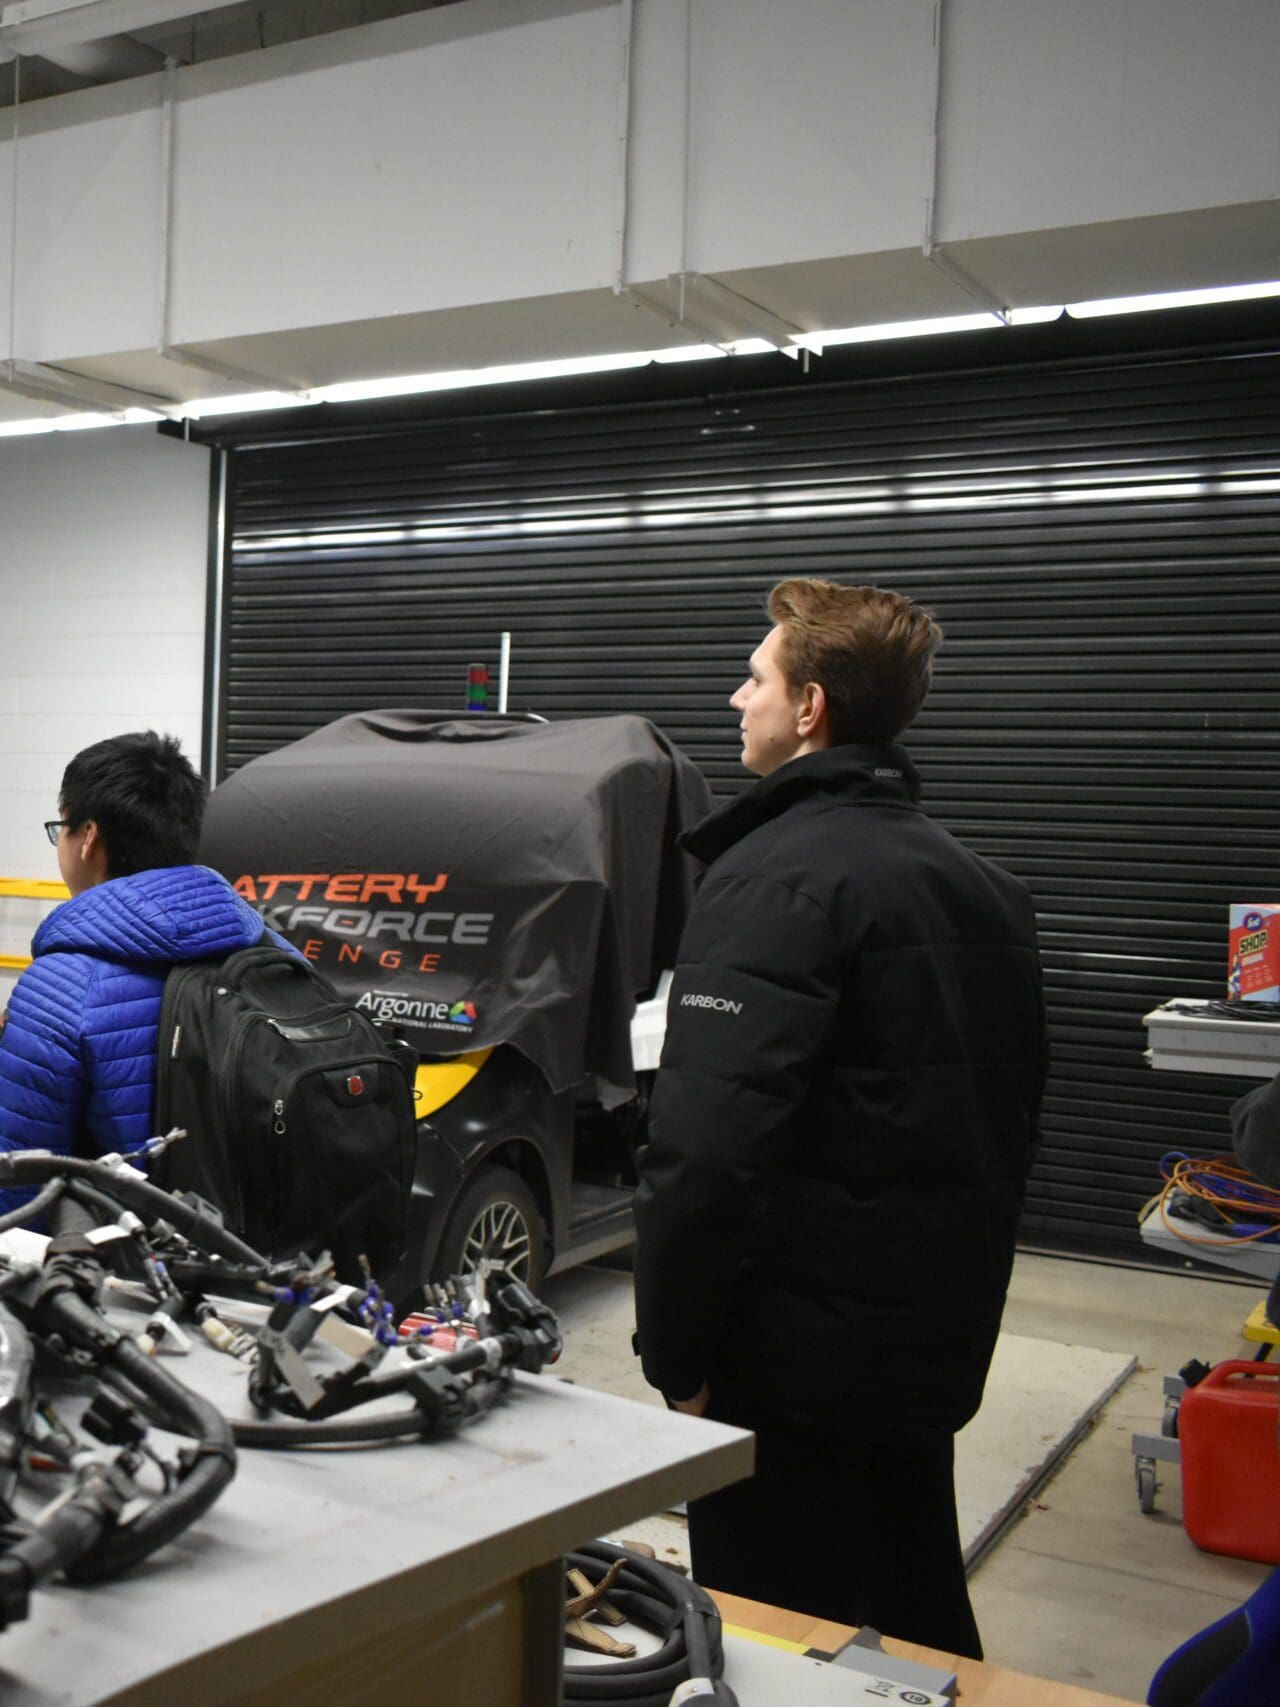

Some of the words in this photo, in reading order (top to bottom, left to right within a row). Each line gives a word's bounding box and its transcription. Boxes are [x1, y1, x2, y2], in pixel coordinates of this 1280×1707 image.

[232, 874, 448, 903] ATTERY
[258, 904, 494, 944] KFORCE
[303, 938, 441, 973] ENGE
[1240, 932, 1267, 953] SHOP
[355, 991, 449, 1020] Argonne
[680, 993, 743, 1015] KARBON
